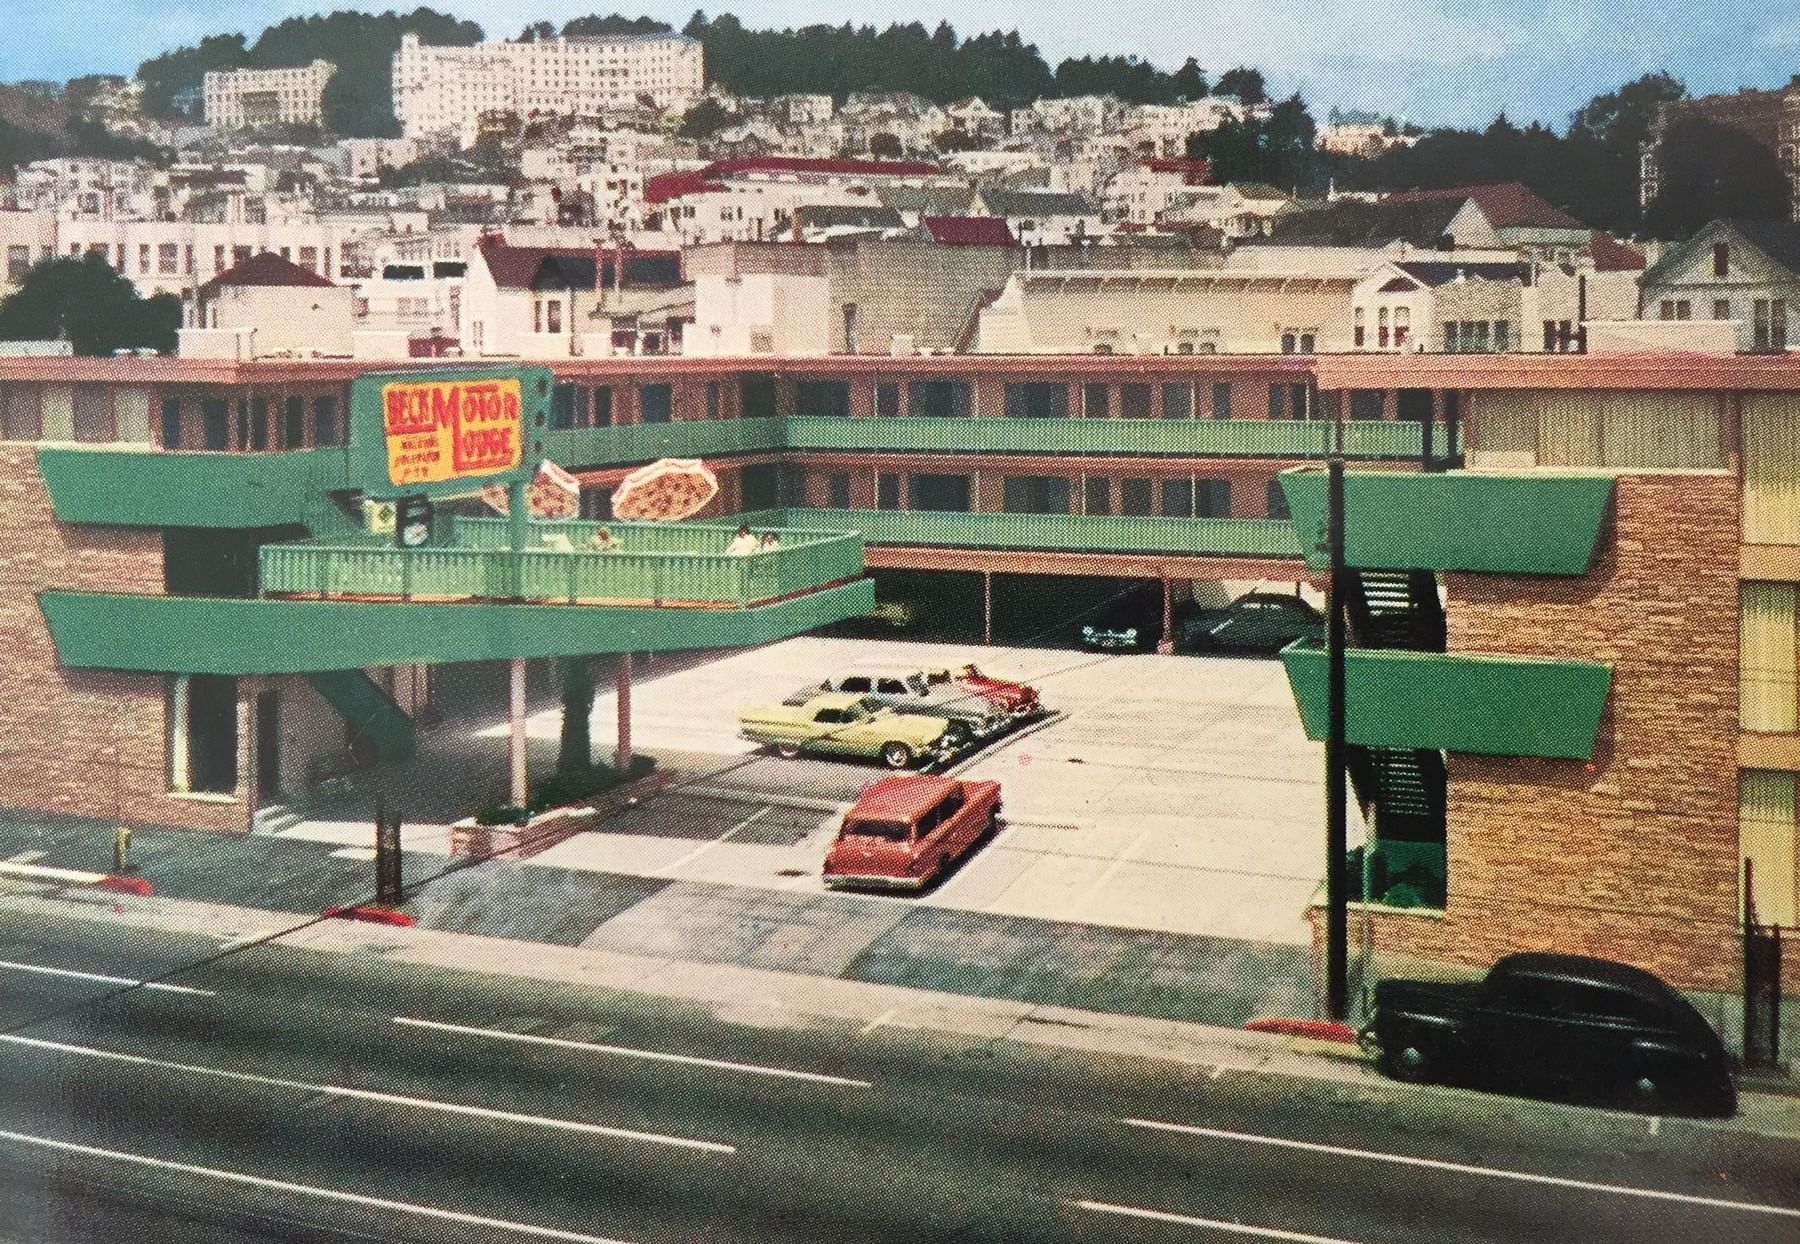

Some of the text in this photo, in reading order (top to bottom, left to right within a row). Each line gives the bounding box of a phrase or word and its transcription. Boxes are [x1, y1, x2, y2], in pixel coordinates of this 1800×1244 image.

[386, 383, 518, 430] BECK MOTOR
[452, 425, 514, 473] LODGE
